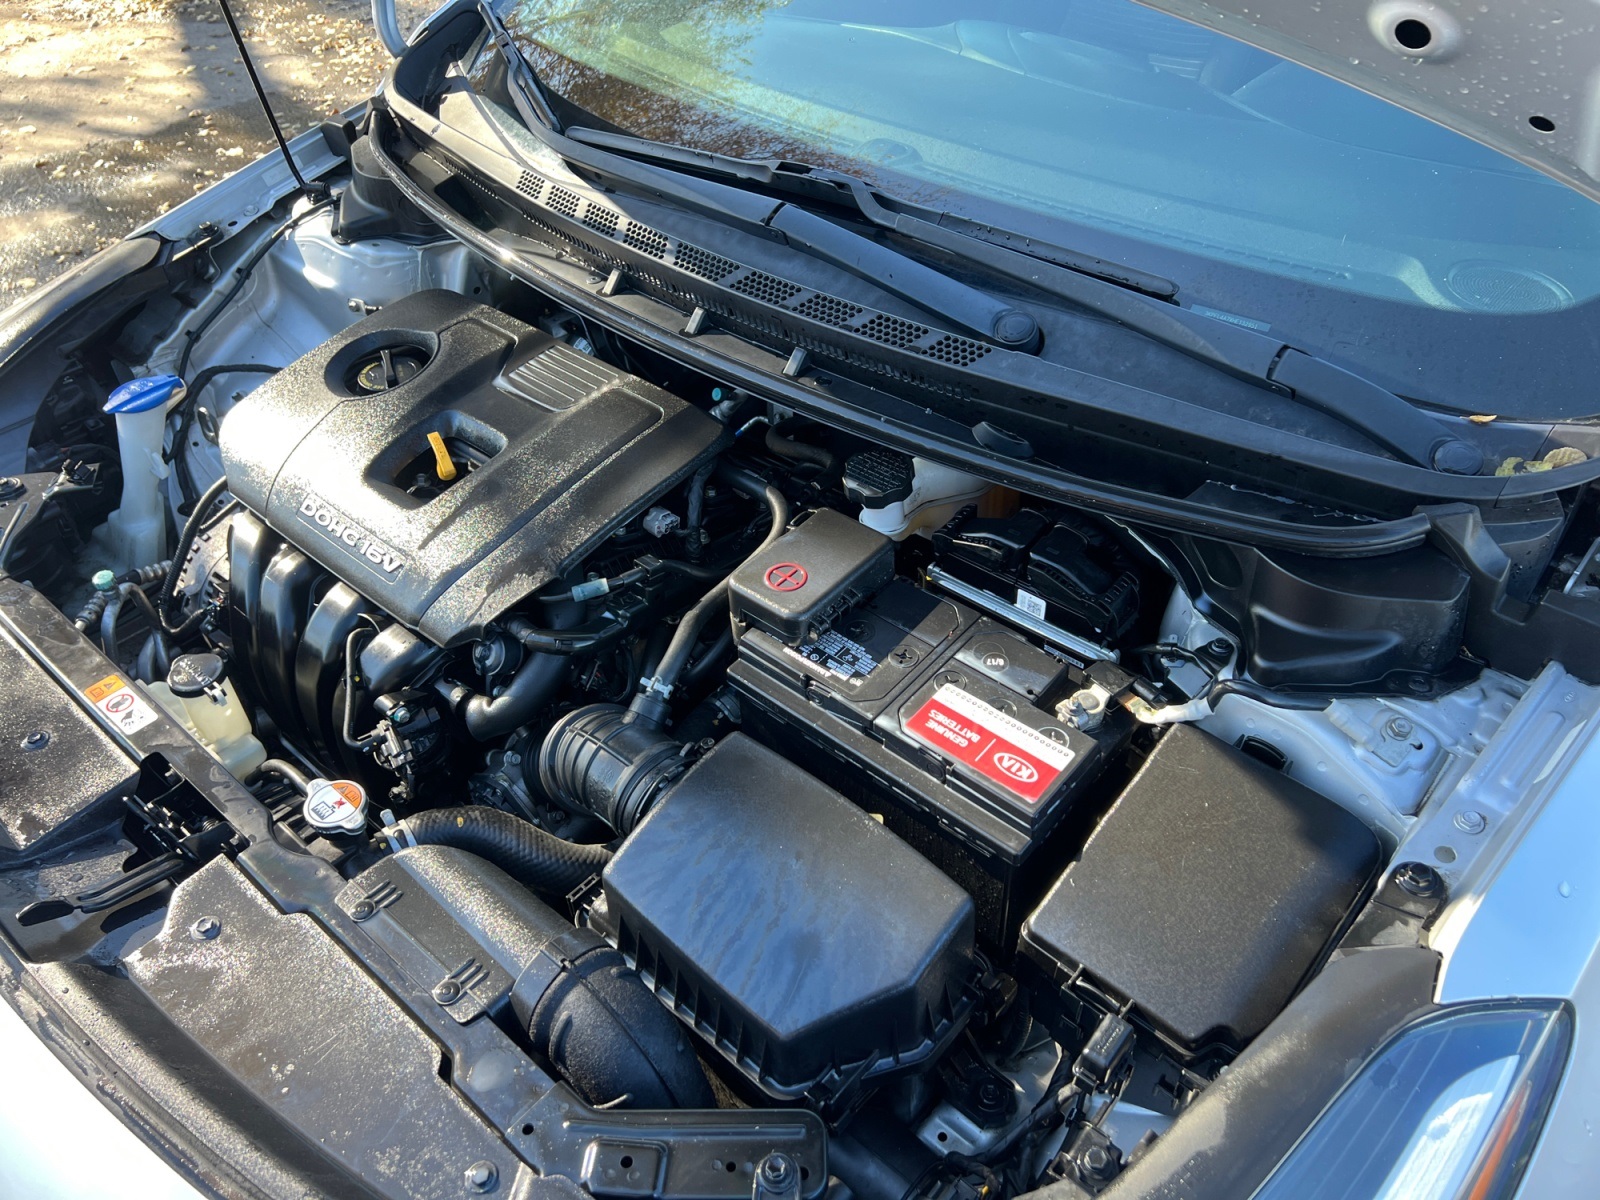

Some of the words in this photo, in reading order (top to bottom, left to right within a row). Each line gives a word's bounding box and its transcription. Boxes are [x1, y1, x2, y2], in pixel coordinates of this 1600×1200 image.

[300, 499, 361, 547] DOHC
[359, 541, 402, 573] 16V
[925, 718, 969, 748] GENUINE
[928, 709, 981, 744] BATTERIES
[1000, 754, 1034, 780] KIA
